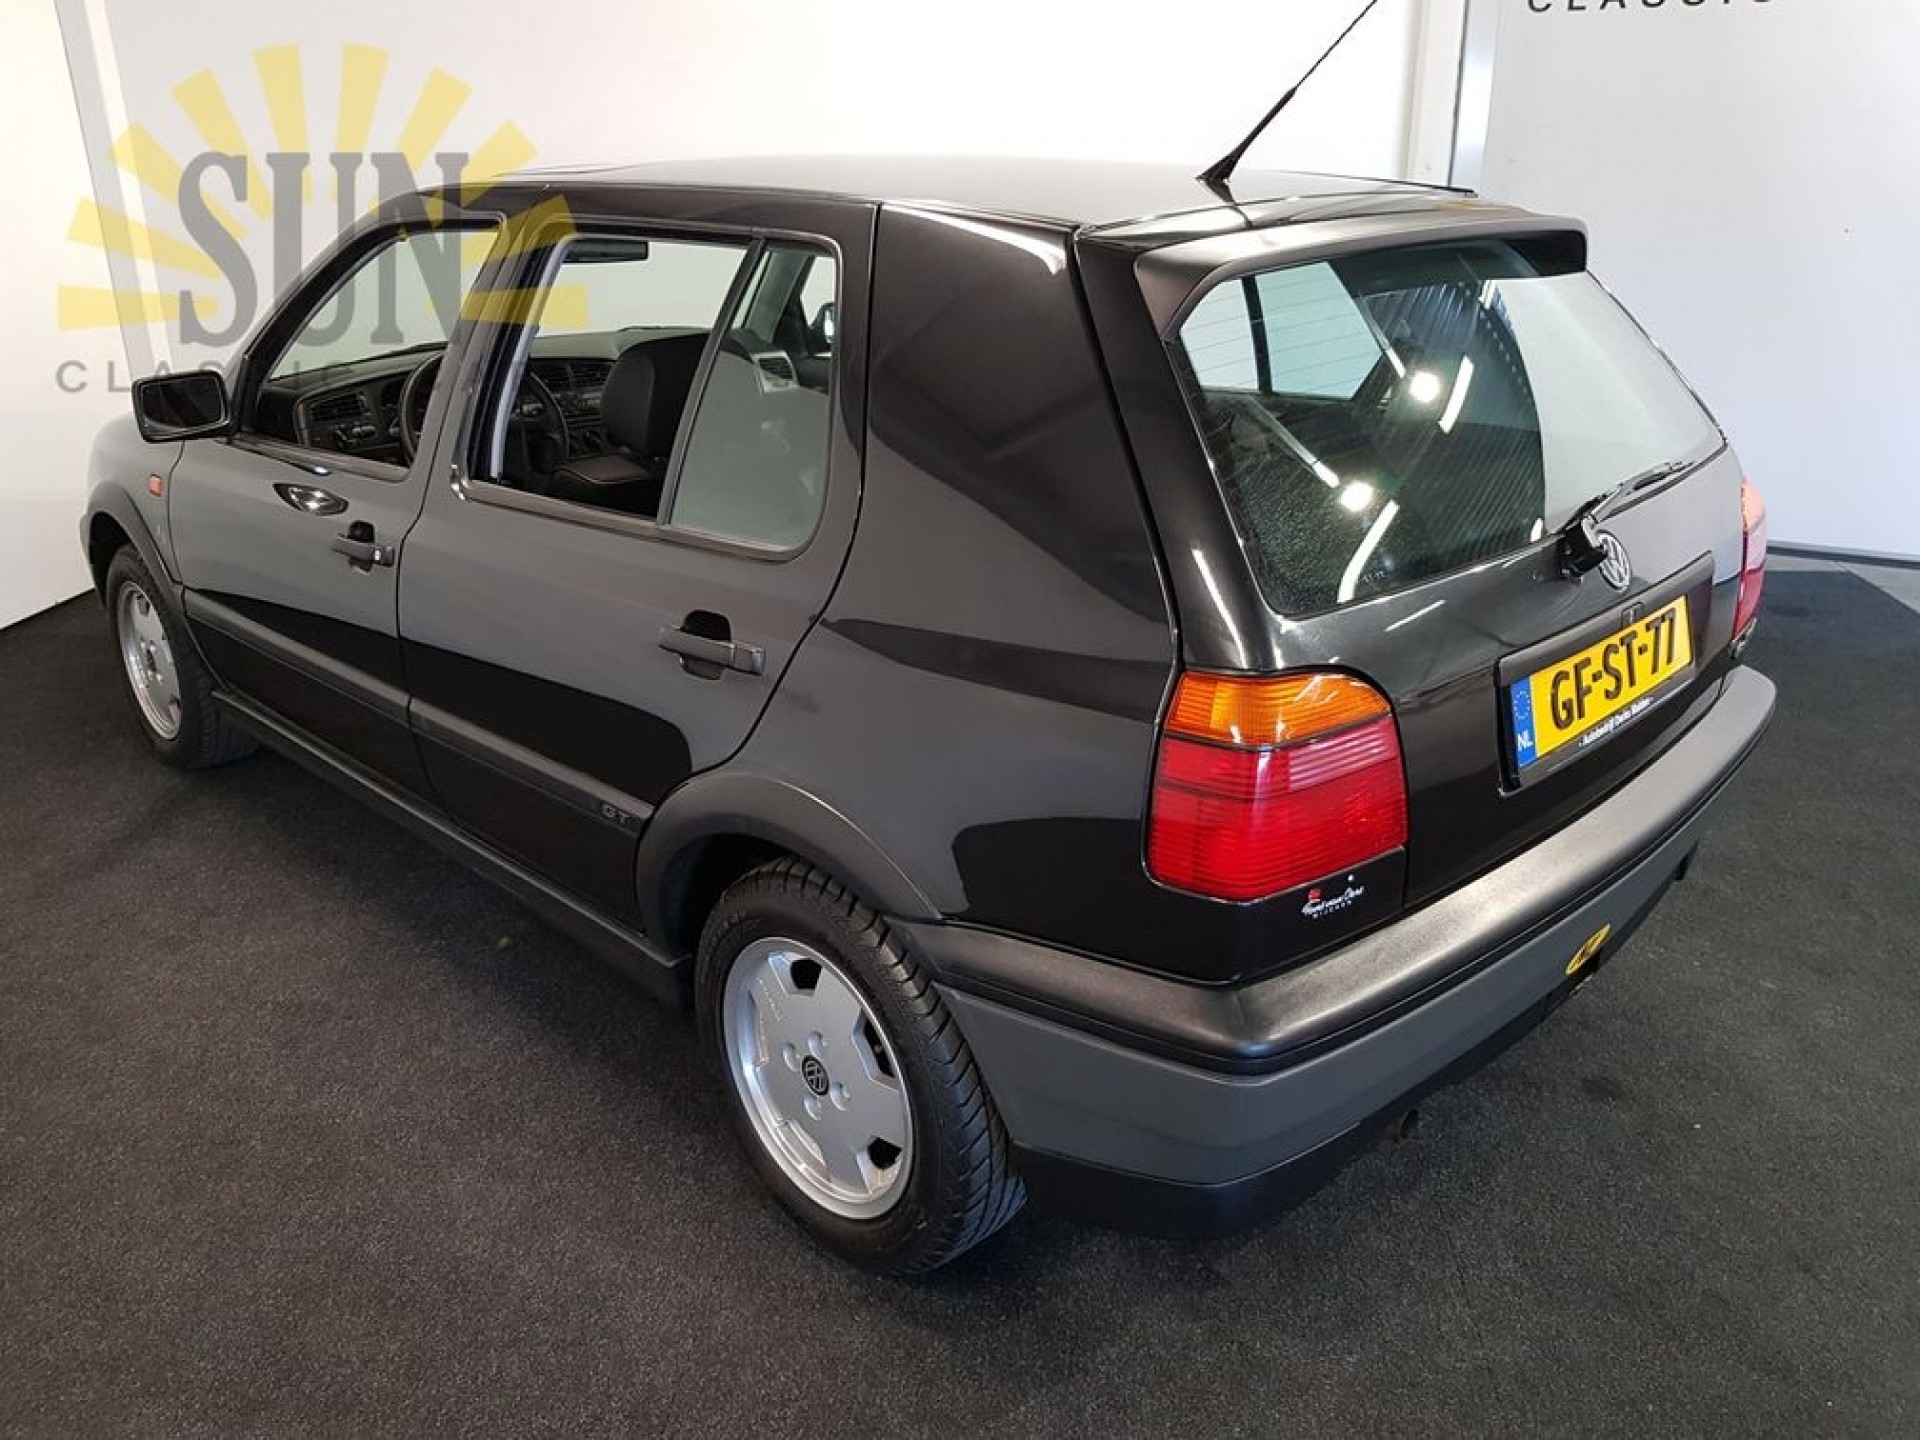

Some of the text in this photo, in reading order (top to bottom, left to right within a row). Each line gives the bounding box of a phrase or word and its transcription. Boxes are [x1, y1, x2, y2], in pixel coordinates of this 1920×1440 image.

[1551, 607, 1677, 730] GF-ST-77
[1517, 730, 1534, 751] NL
[601, 804, 630, 825] GT
